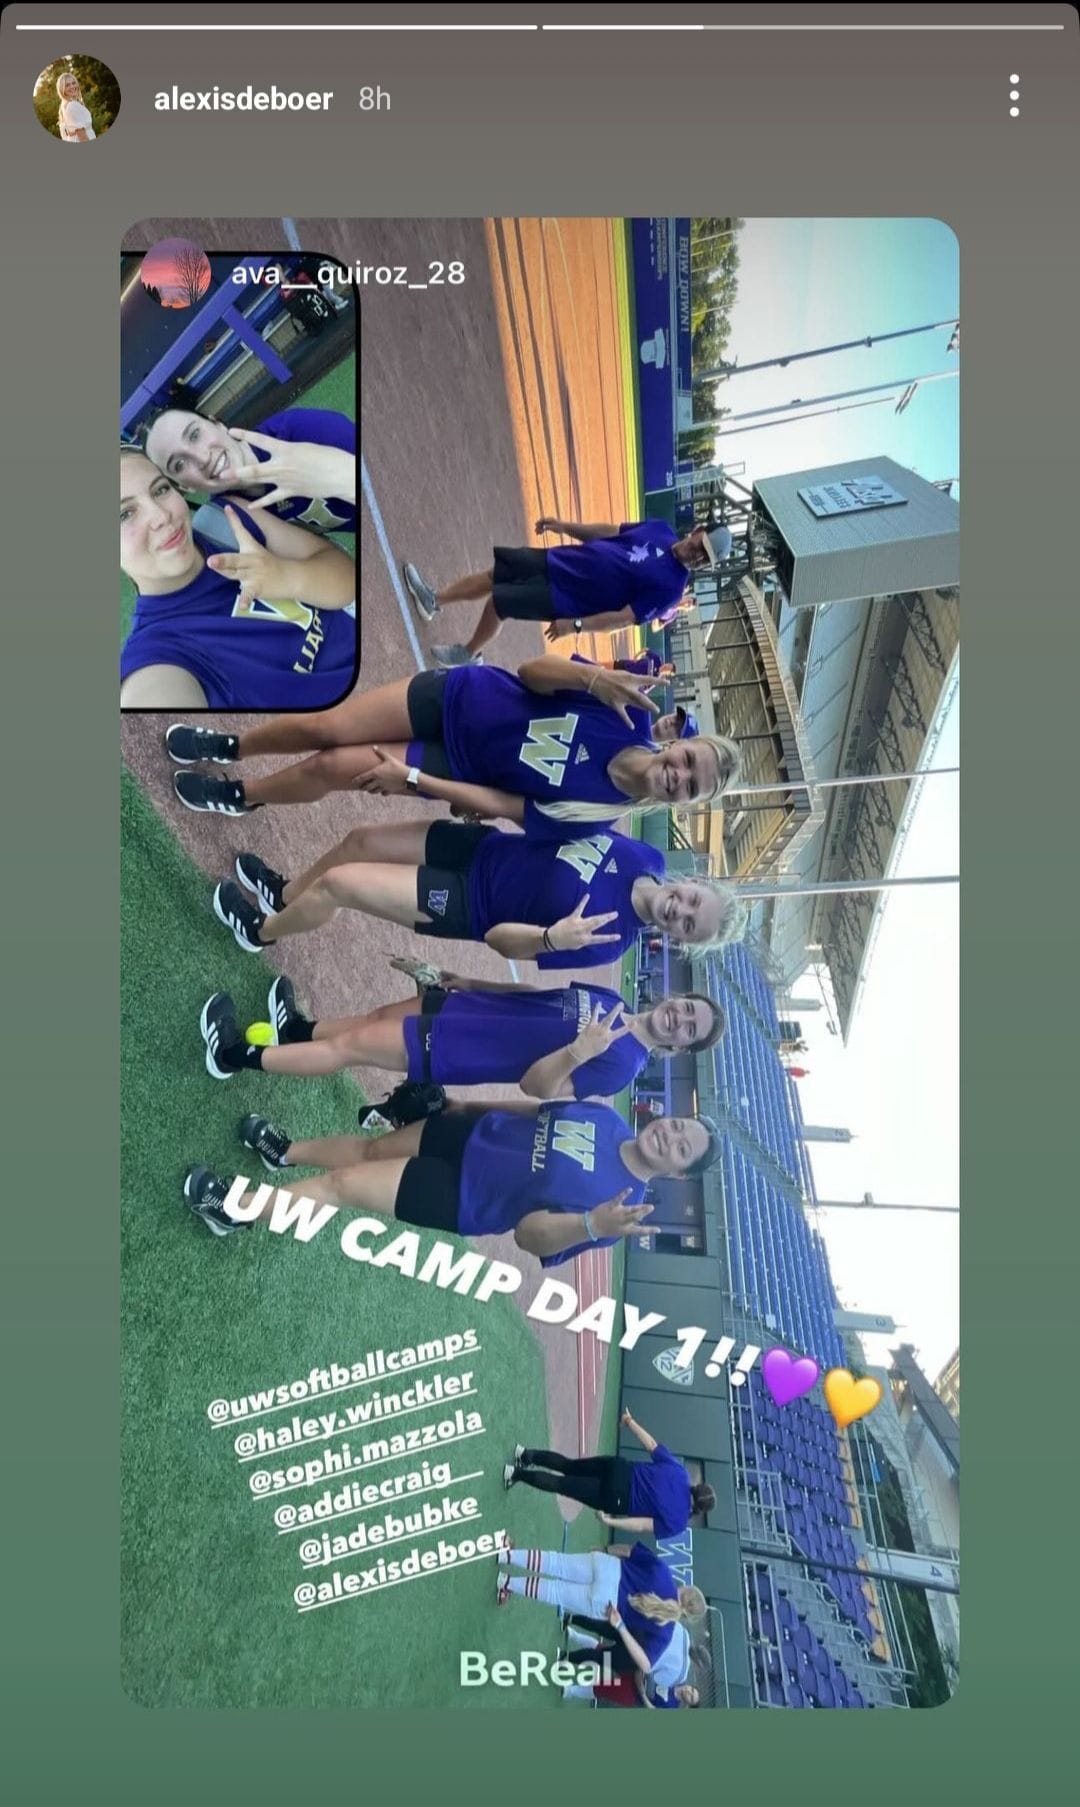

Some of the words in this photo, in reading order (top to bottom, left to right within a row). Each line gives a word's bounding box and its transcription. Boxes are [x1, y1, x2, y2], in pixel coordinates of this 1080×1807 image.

[679, 235, 690, 273] BOW
[679, 279, 690, 332] DOWN!
[519, 712, 579, 787] W
[556, 834, 613, 885] W
[427, 889, 449, 916] W
[552, 1119, 596, 1172] W
[875, 1318, 886, 1327] 3
[930, 1565, 943, 1577] 4
